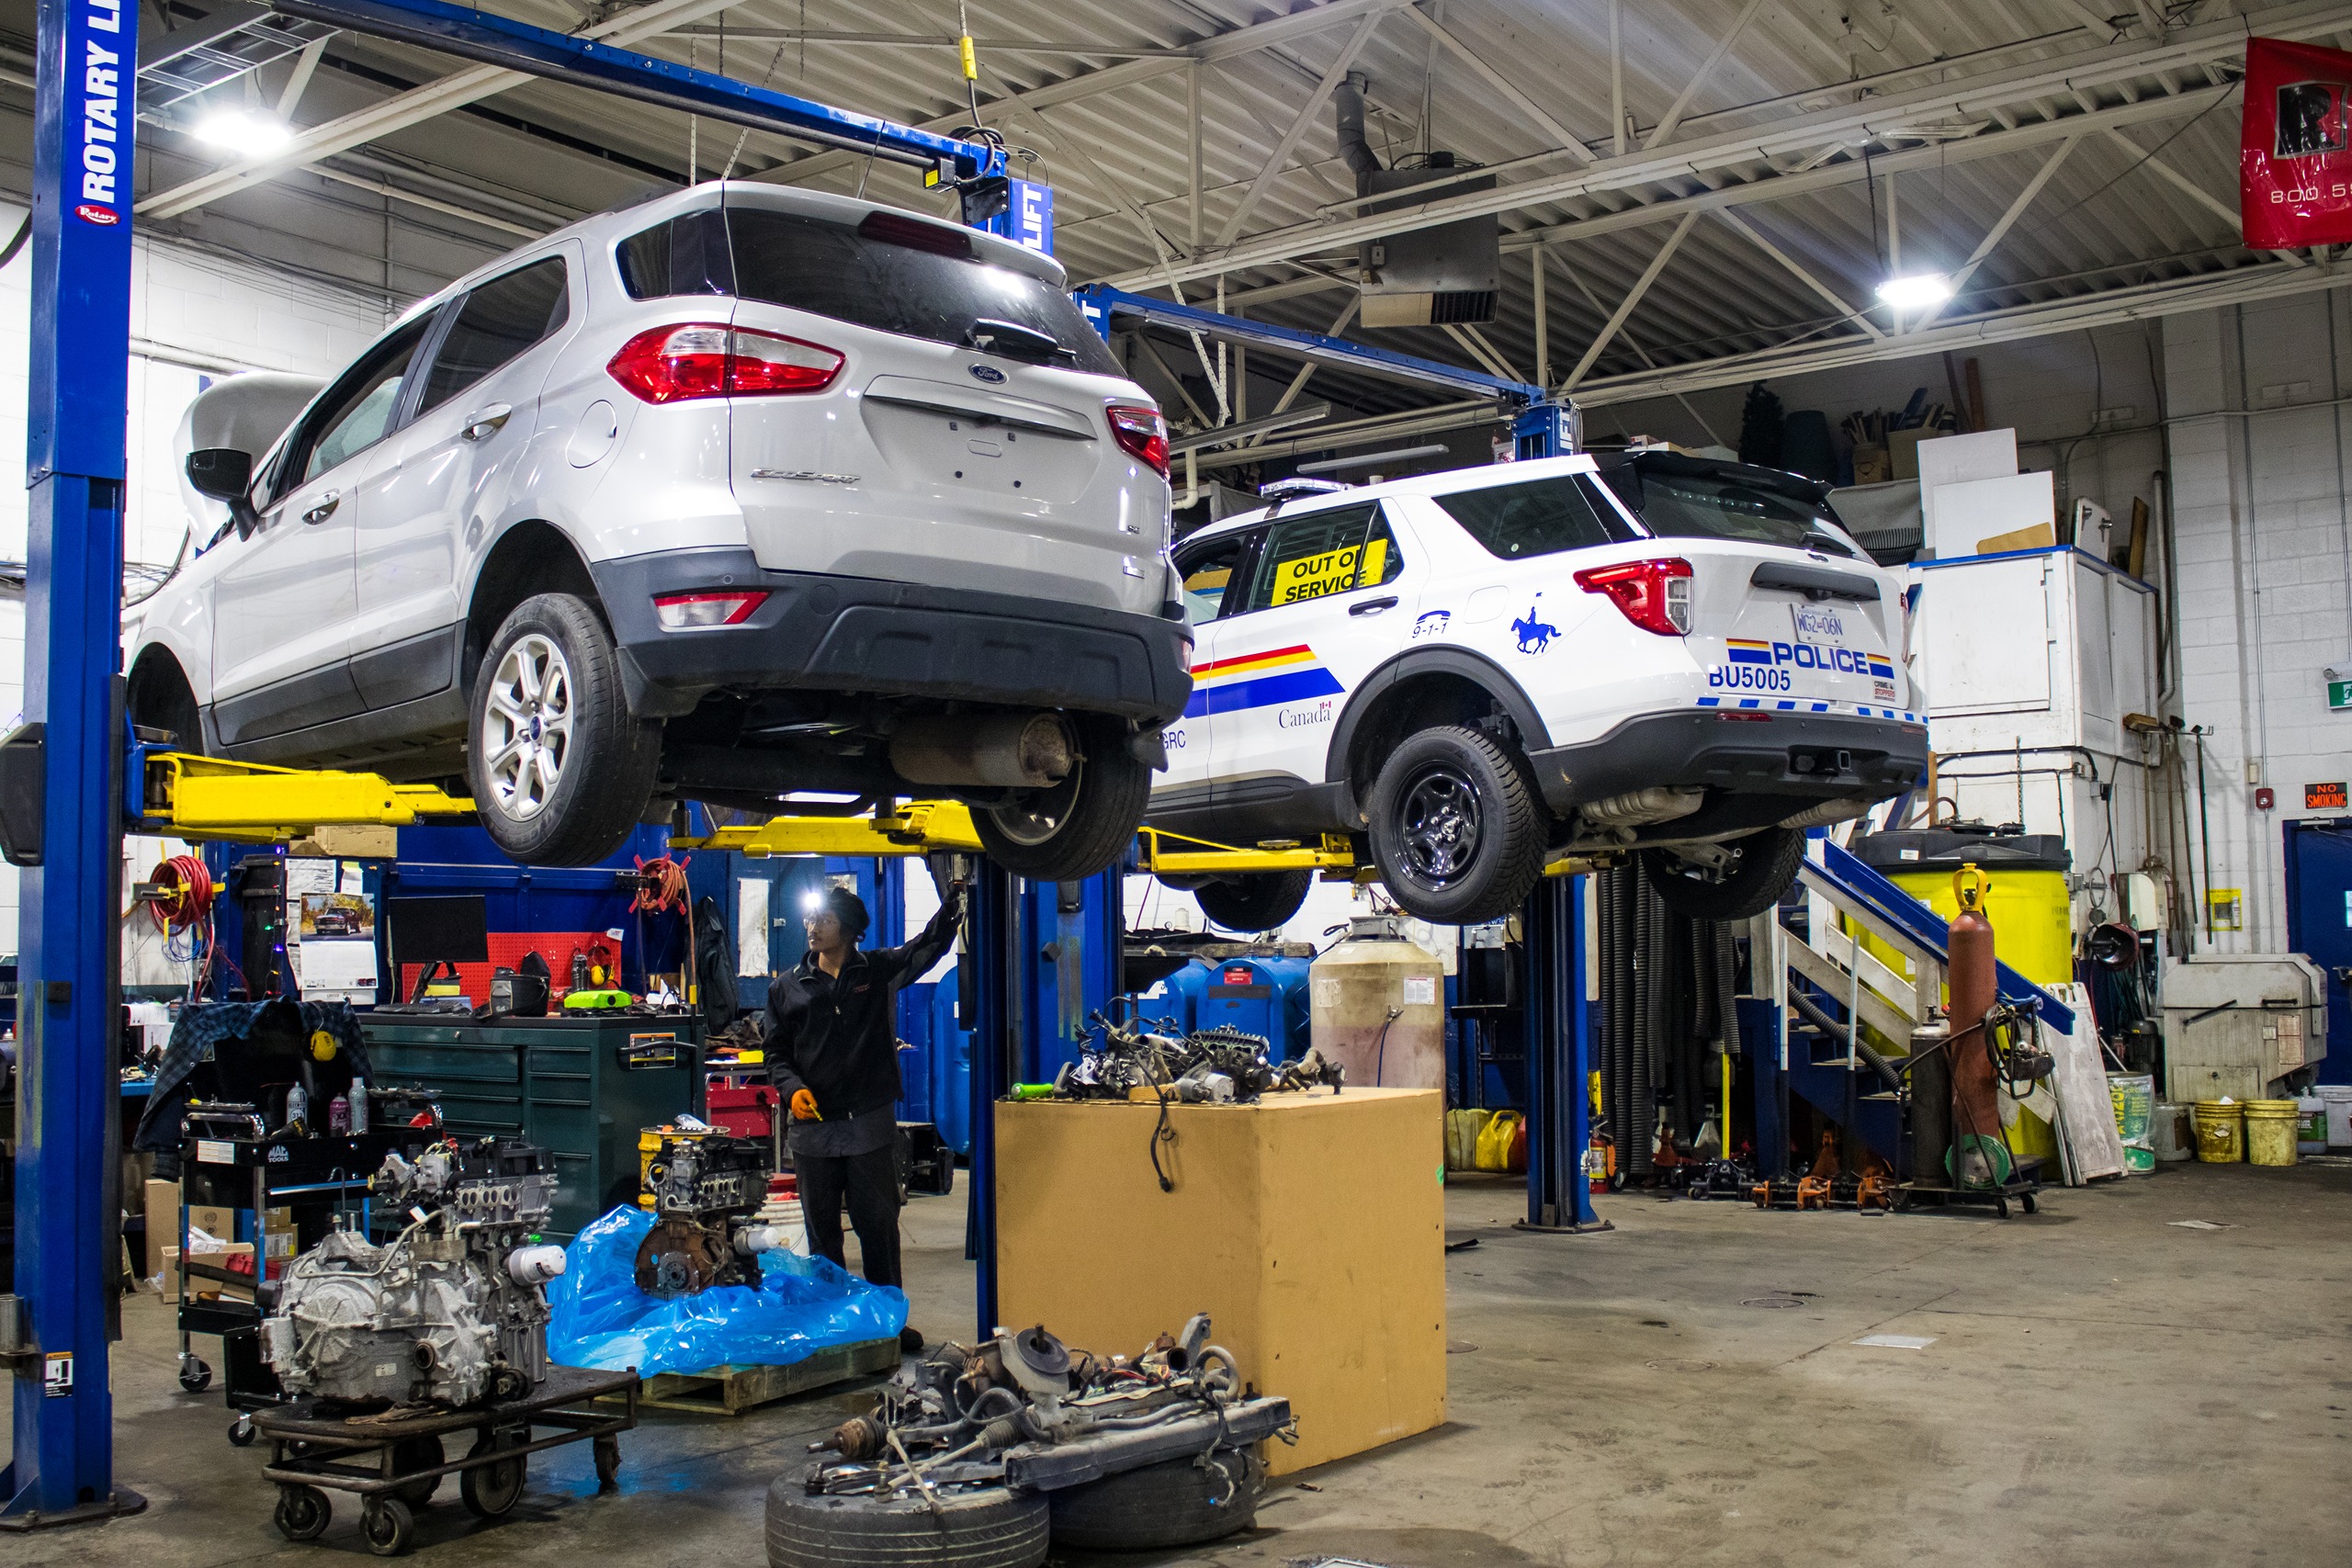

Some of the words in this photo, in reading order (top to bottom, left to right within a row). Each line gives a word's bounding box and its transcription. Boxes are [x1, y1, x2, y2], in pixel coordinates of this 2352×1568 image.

[83, 39, 119, 203] ROTARY
[2271, 183, 2352, 204] 800.5
[79, 204, 117, 221] Rotary
[1023, 183, 1043, 250] LIFT
[977, 367, 1000, 380] Ford
[1559, 408, 1574, 456] IFT
[1293, 555, 1335, 579] OUT
[1284, 570, 1367, 603] SERVICE
[1412, 622, 1448, 638] 9-1-1
[1771, 642, 1869, 675] POLICE
[1709, 665, 1791, 692] BU5005
[1278, 703, 1331, 728] Canada
[2307, 793, 2346, 808] SMOKING
[2316, 784, 2337, 794] NO
[267, 1145, 288, 1158] MAC
